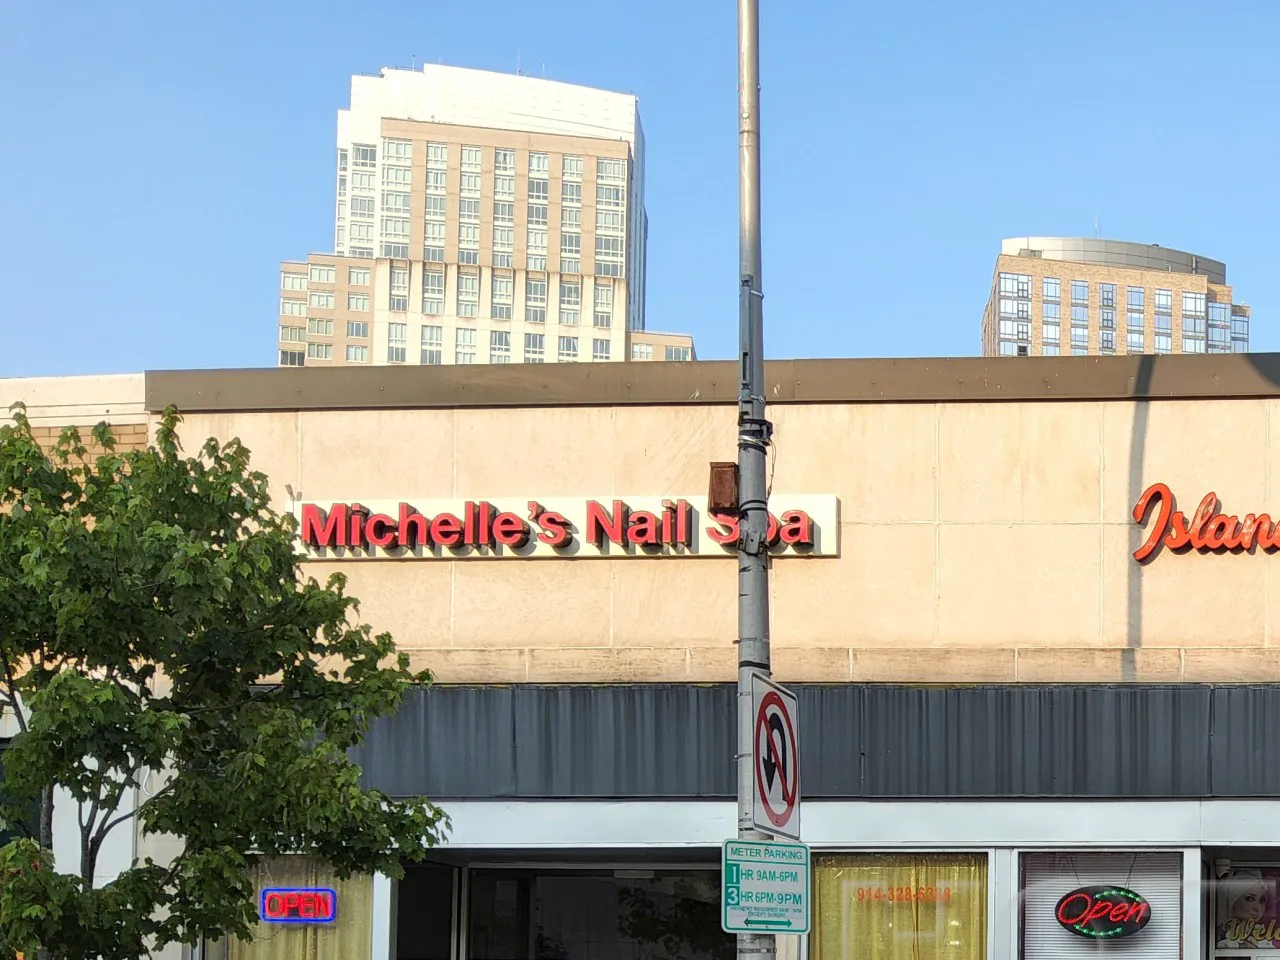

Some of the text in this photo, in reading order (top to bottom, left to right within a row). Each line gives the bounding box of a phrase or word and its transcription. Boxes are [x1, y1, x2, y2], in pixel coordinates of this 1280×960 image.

[300, 500, 570, 548] Michelle's
[586, 499, 689, 545] Nail
[730, 847, 803, 860] METER PARKING
[732, 866, 798, 883] 1 HR 9AM-6PM
[264, 892, 333, 918] OPEN
[727, 887, 802, 905] 3 HR 6PM-9PM
[1057, 893, 1149, 928] Open
